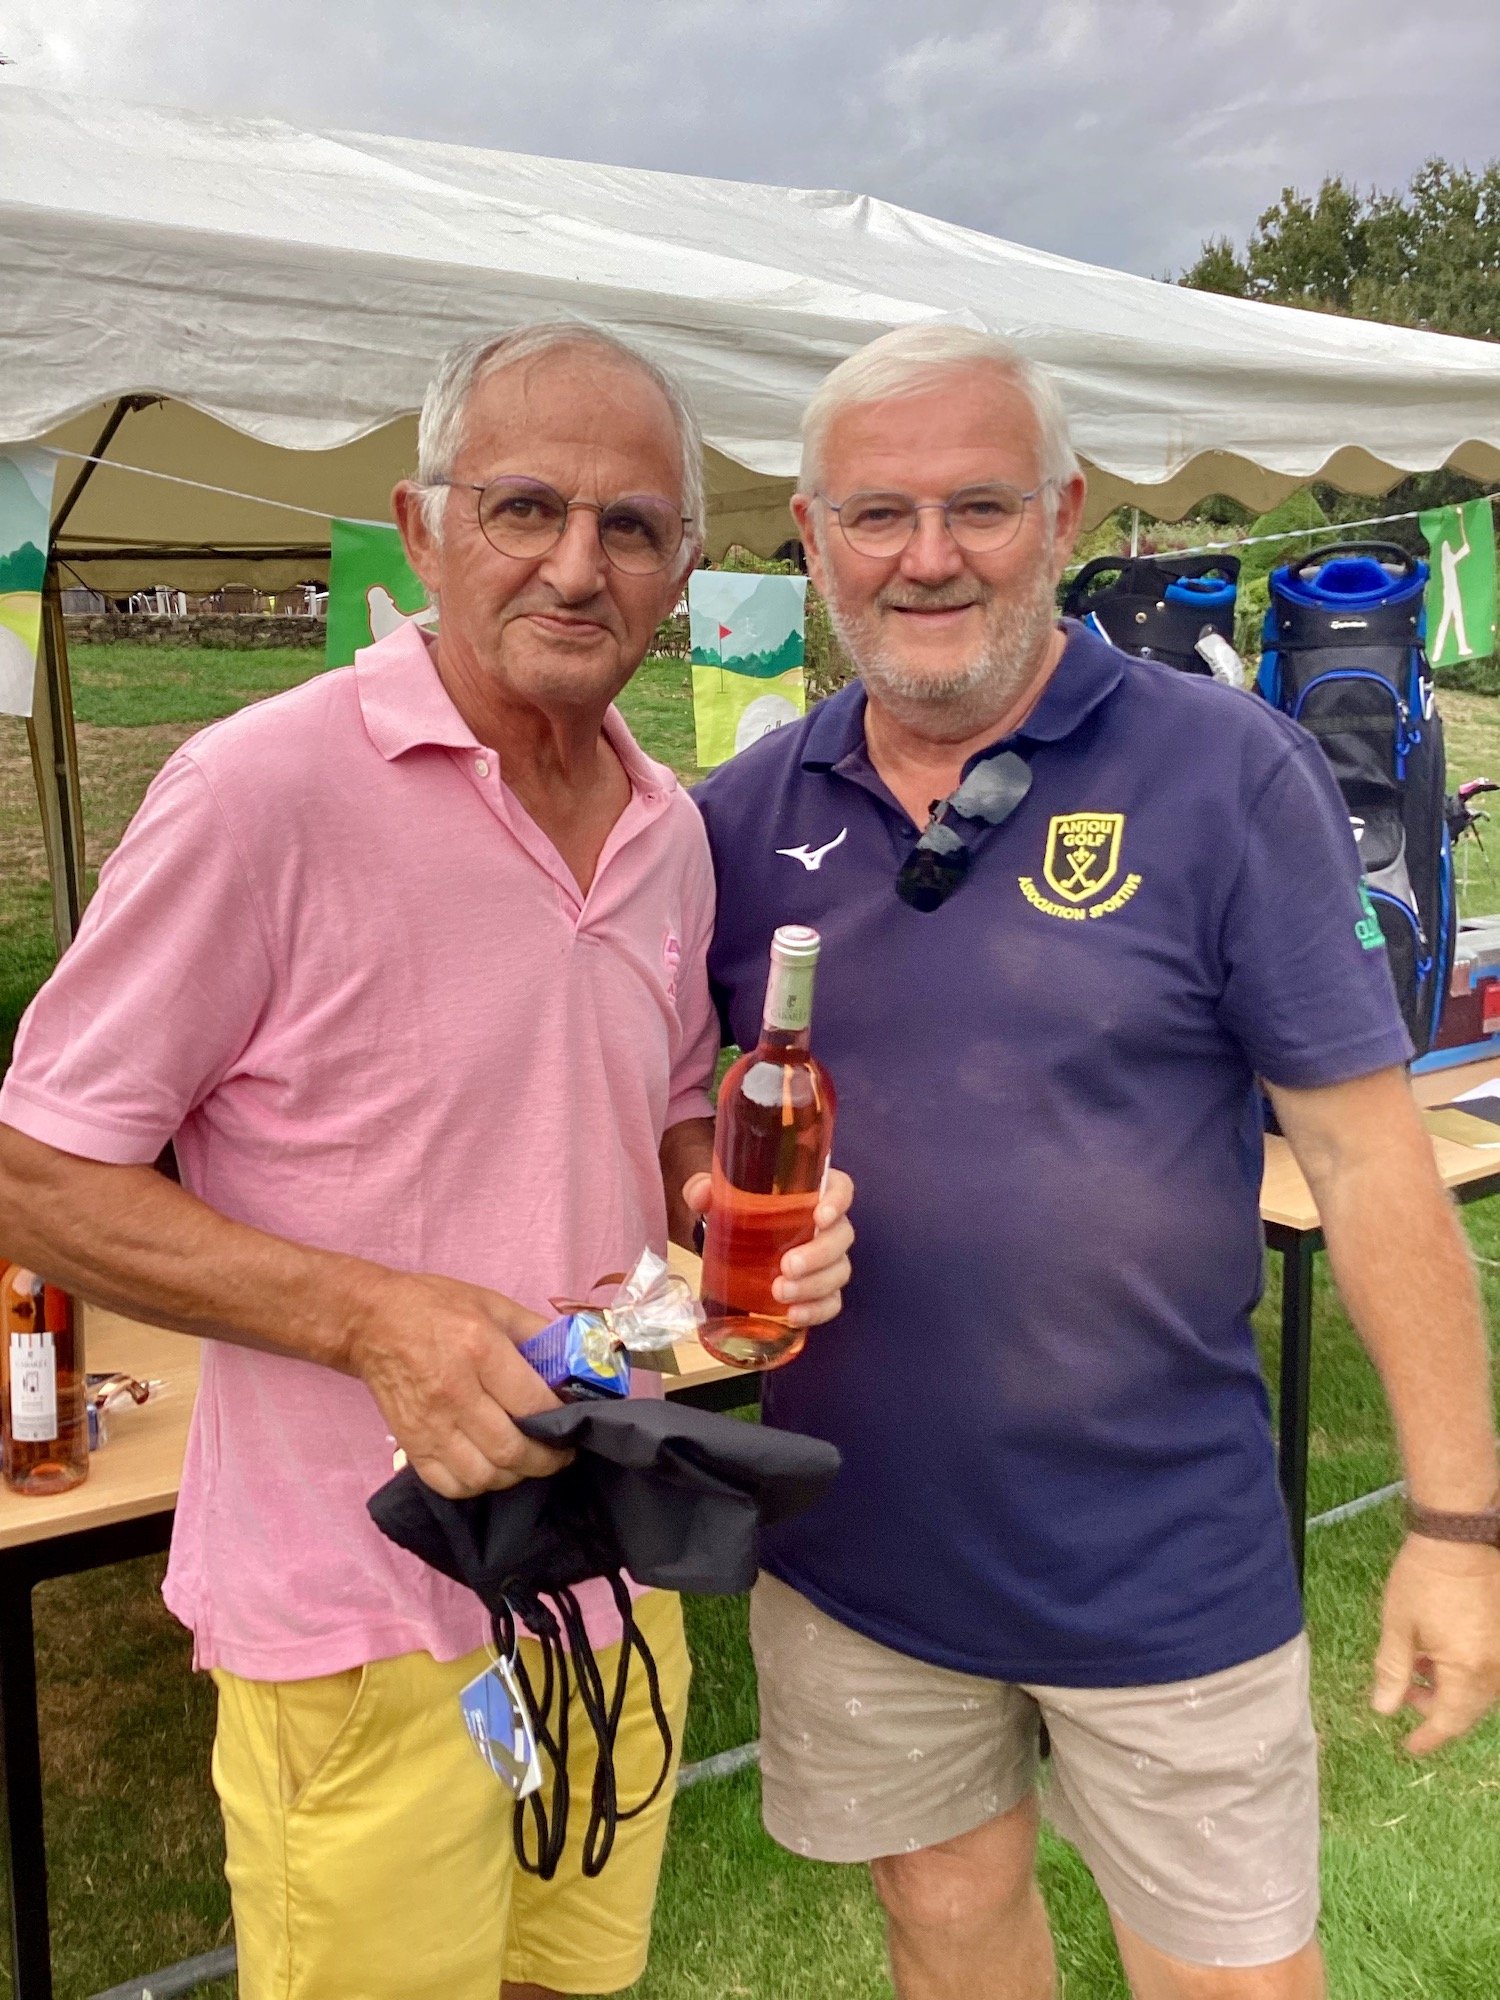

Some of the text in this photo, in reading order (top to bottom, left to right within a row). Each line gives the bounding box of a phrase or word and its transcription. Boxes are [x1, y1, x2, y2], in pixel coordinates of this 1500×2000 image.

[1058, 820, 1112, 834] ANJOU
[1063, 833, 1106, 847] GOLF
[1088, 873, 1143, 919] SPORTIVE
